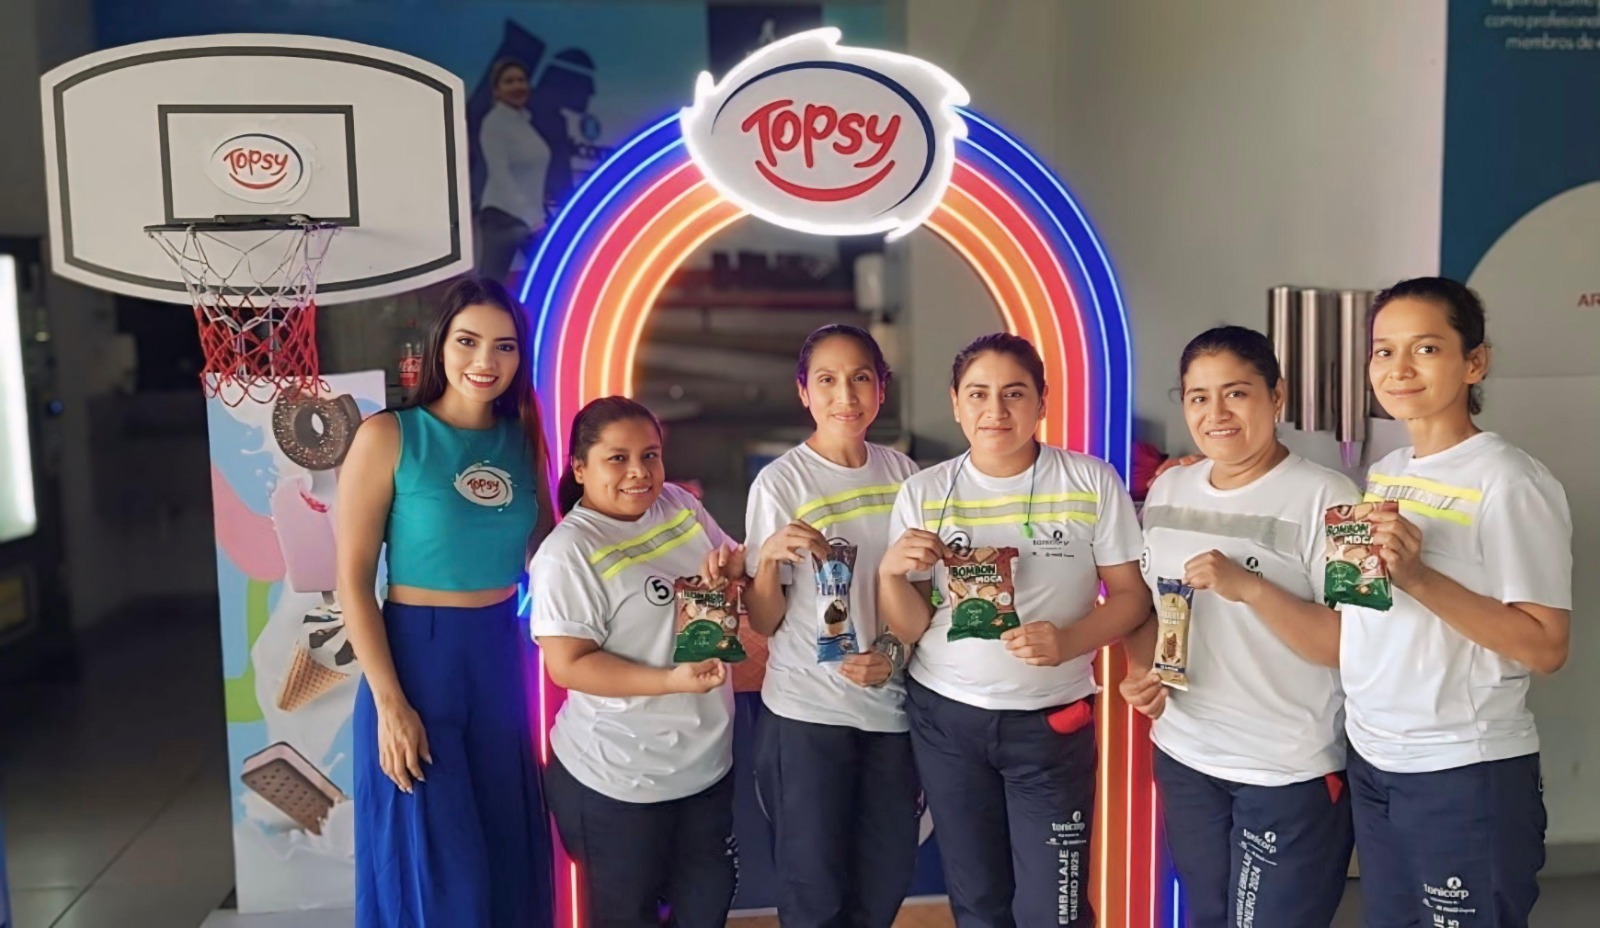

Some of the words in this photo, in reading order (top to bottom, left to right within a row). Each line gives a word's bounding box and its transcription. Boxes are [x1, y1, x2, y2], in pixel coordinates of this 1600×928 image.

[950, 562, 996, 579] BOMBON
[975, 575, 1003, 584] MOCA
[651, 579, 670, 600] 5
[1070, 851, 1080, 878] 2025
[1058, 849, 1069, 925] EMBALAJE
